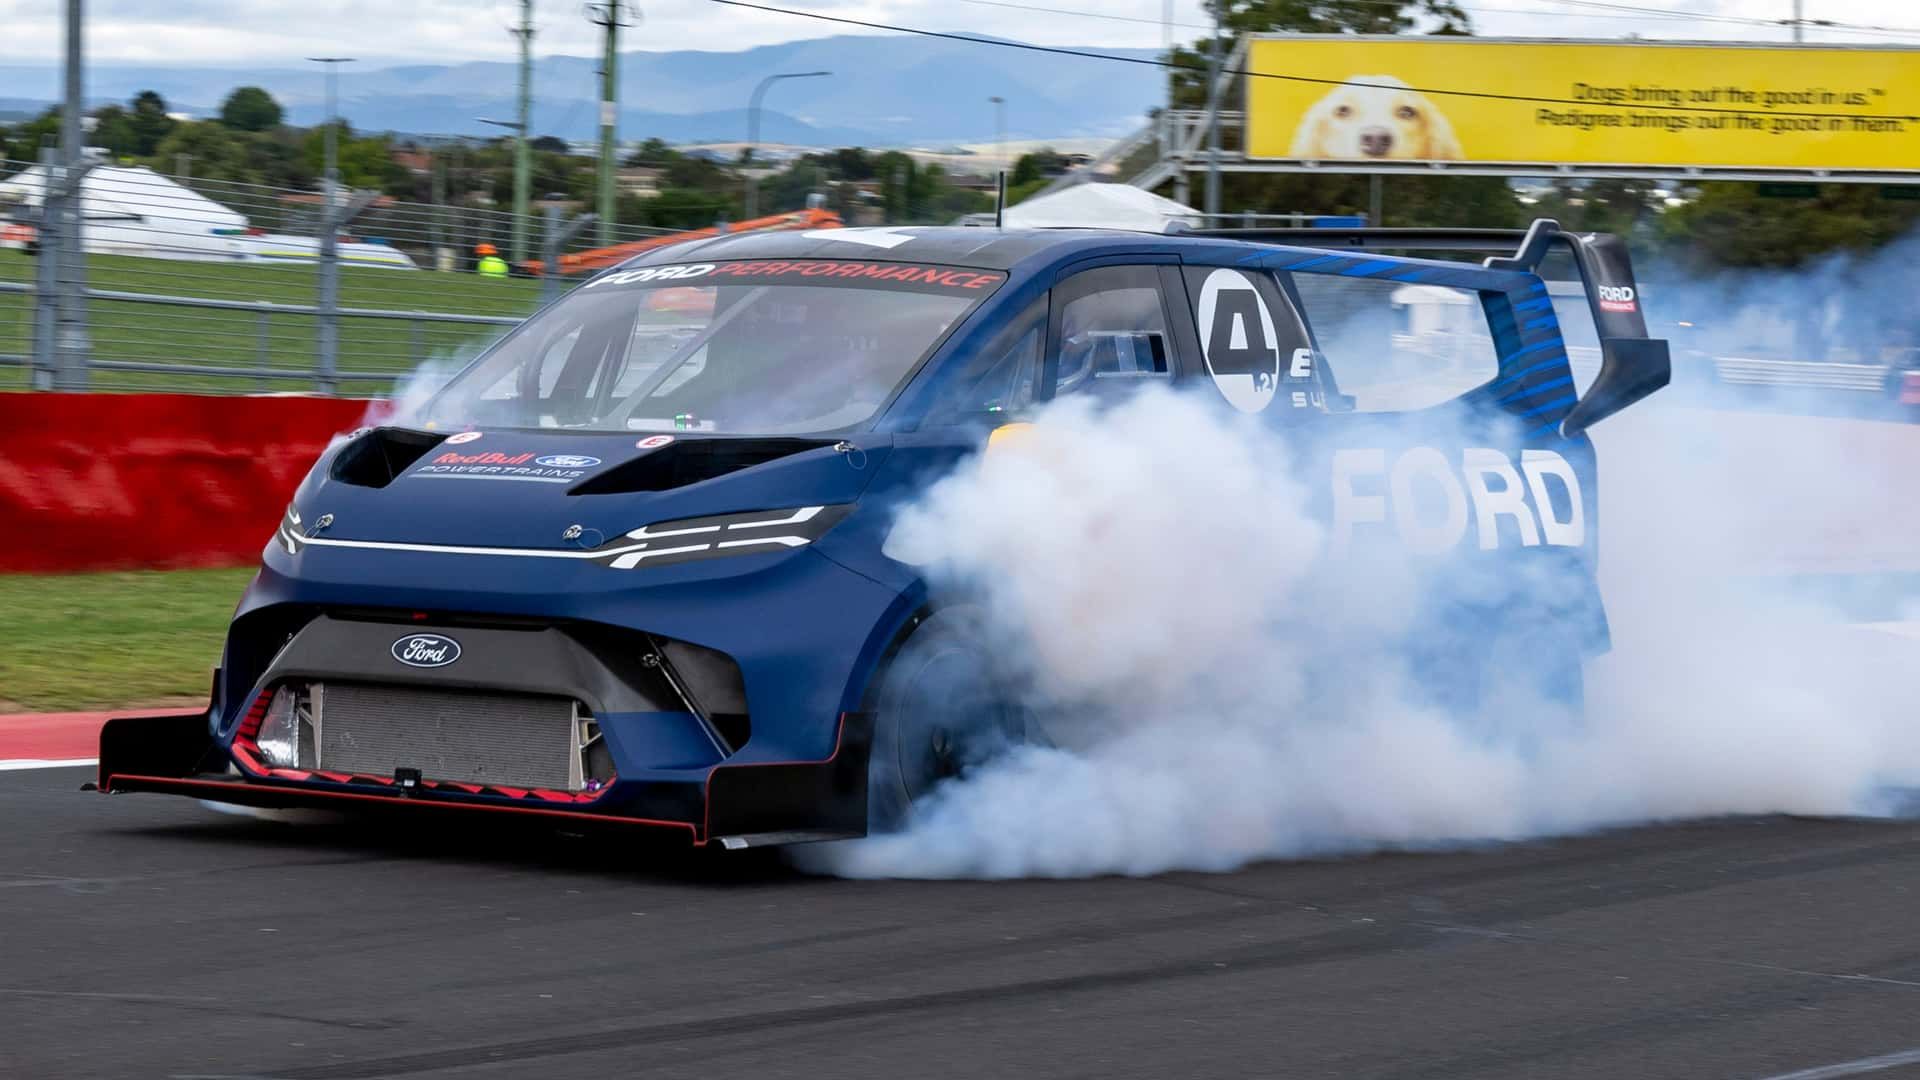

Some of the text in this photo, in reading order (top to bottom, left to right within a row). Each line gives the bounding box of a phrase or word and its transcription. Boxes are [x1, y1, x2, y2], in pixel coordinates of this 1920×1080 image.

[584, 261, 1001, 289] FORD PERFORMANCE
[1598, 285, 1634, 302] FORD
[417, 465, 584, 478] POWERTRAINS
[1332, 447, 1585, 552] FORD
[402, 637, 449, 662] Ford
